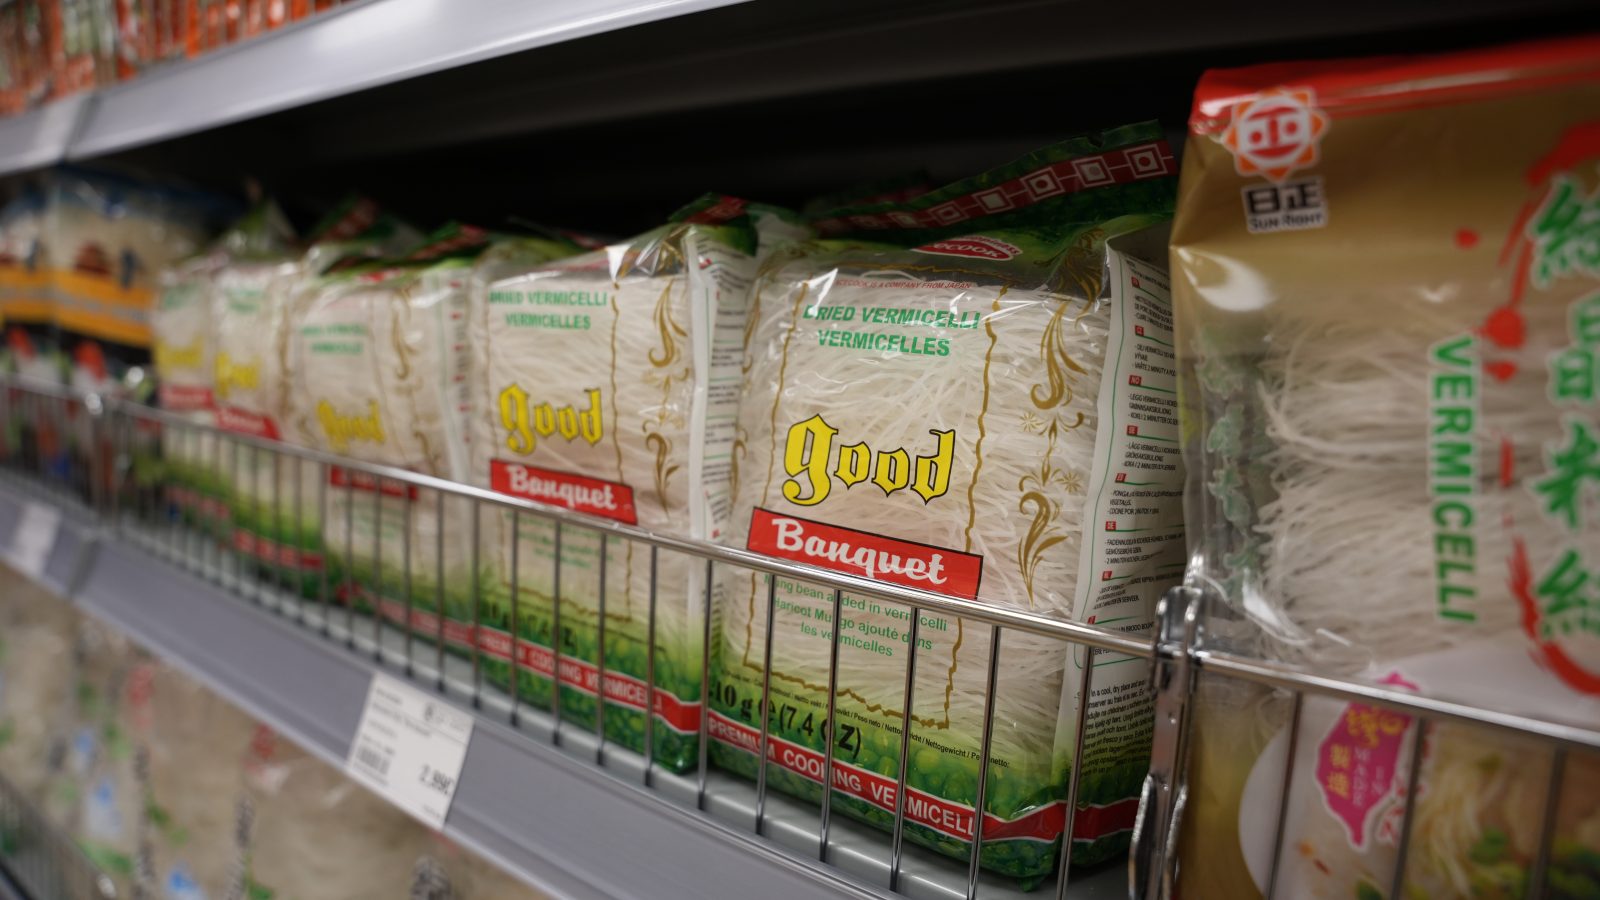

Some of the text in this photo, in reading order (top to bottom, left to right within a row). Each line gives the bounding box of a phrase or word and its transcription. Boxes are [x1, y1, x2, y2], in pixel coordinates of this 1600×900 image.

[1247, 180, 1320, 214] 日正
[527, 293, 607, 306] VERMICELLI
[885, 281, 923, 289] COMPANY
[505, 313, 591, 330] VERMICELLES
[802, 304, 980, 329] DRIED VERMICELLI
[818, 330, 950, 356] VERMICELLES
[1130, 376, 1140, 385] NO
[499, 383, 603, 456] good
[782, 413, 956, 507] good
[506, 466, 617, 510] Banquet
[1433, 337, 1477, 623] VERMICELLI
[771, 518, 949, 585] Banquet
[796, 579, 824, 600] bean
[827, 592, 865, 611] aded
[869, 598, 881, 614] in
[775, 597, 932, 651] Haricot Mugo ajouté dns
[801, 621, 893, 657] les vemicelles
[780, 703, 814, 737] (7.4
[853, 712, 868, 725] Peso
[868, 718, 881, 729] neto
[926, 737, 966, 758] Nettogewicht
